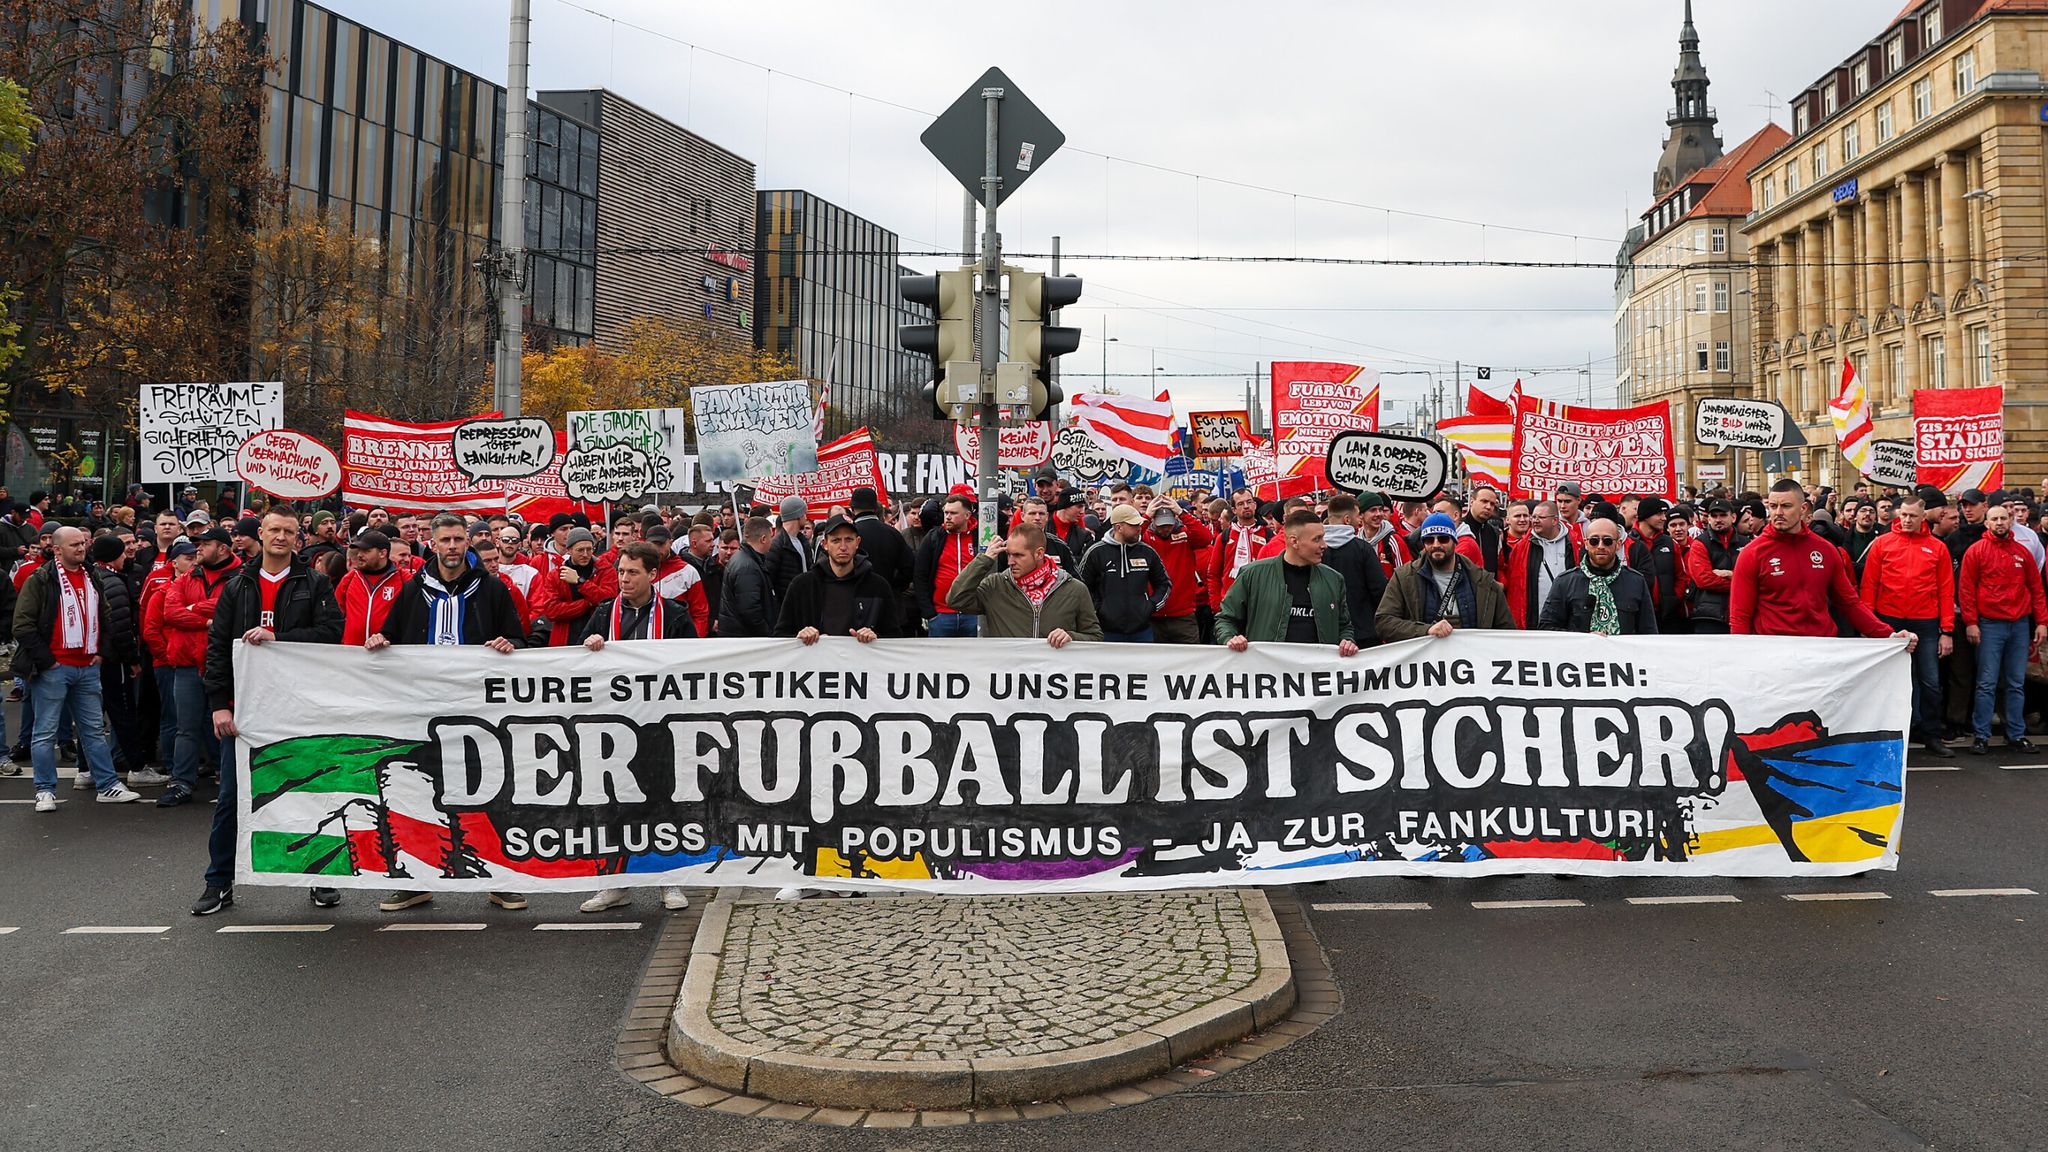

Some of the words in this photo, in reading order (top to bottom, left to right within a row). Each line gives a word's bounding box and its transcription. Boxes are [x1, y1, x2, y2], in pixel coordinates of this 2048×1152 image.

[694, 384, 811, 416] FANKULTUR
[1303, 399, 1328, 408] LEBT
[1330, 401, 1351, 409] VON
[460, 420, 542, 440] REPRESSION
[576, 412, 597, 433] DIE
[603, 410, 651, 433] STADIEN
[696, 408, 809, 435] ERHALTEN
[1280, 413, 1370, 429] EMOTIONEN
[1525, 414, 1604, 437] FREIHEIT
[1605, 421, 1634, 436] FÜR
[1636, 417, 1662, 430] DIE
[1703, 415, 1718, 426] DIE
[1721, 417, 1743, 428] BILD
[1745, 420, 1772, 432] UNTER
[1920, 423, 1942, 432] ZIS
[1945, 422, 1977, 433] 24/25
[1000, 431, 1038, 444] KEINE
[1194, 426, 1237, 441] Fußba
[1299, 428, 1329, 437] NICHT
[1700, 428, 1717, 438] DEN
[265, 433, 300, 452] GEGEN
[349, 437, 452, 460] BRENNE
[1060, 433, 1103, 451] SCHLUS
[1523, 430, 1662, 459] KURVEN
[248, 443, 321, 470] ÜBERWACHUNG
[569, 452, 605, 469] HABEN
[608, 448, 633, 465] WIR
[856, 451, 870, 460] UM
[1071, 447, 1093, 456] MIT
[1346, 441, 1370, 456] LAW
[1372, 445, 1382, 457] &
[1384, 447, 1427, 466] ORDER
[1920, 449, 1962, 460] SIND
[1965, 445, 2001, 459] SICHE
[153, 446, 238, 476] STOPPE
[246, 462, 266, 474] UND
[350, 454, 406, 469] HERZEN
[407, 460, 440, 472] UND
[1054, 452, 1124, 473] POPULISMUS!
[1339, 455, 1365, 470] WAR
[1369, 459, 1390, 473] ALS
[1521, 456, 1622, 475] SCHLUSS
[1626, 459, 1665, 475] MIT
[1895, 460, 1916, 470] UNSE
[387, 469, 430, 481] GEGEN
[568, 469, 597, 483] KEINE
[599, 462, 647, 479] ANDEREN
[1335, 471, 1369, 486] SCHON
[350, 473, 422, 493] KALTES
[849, 478, 874, 486] ENDE
[1519, 475, 1665, 492] REPSSIONEN!
[486, 675, 593, 703] EURE
[610, 671, 868, 702] STATISTIKEN
[888, 672, 970, 700] UND
[989, 672, 1148, 700] UNSERE
[1164, 658, 1476, 700] WAHRNEHMUNG
[1491, 660, 1649, 688] ZEIGEN:
[435, 723, 647, 805] DER
[671, 717, 1132, 824] FUßBALL
[1154, 716, 1310, 801] IST
[1336, 704, 1729, 794] SICHER!
[506, 822, 705, 857] SCHLUSS
[737, 824, 809, 853] MIT
[843, 825, 1122, 857] POPULISMUS
[1204, 820, 1250, 852] JA
[1284, 814, 1366, 847] ZUR
[1401, 805, 1655, 839] FANKULTUR!
